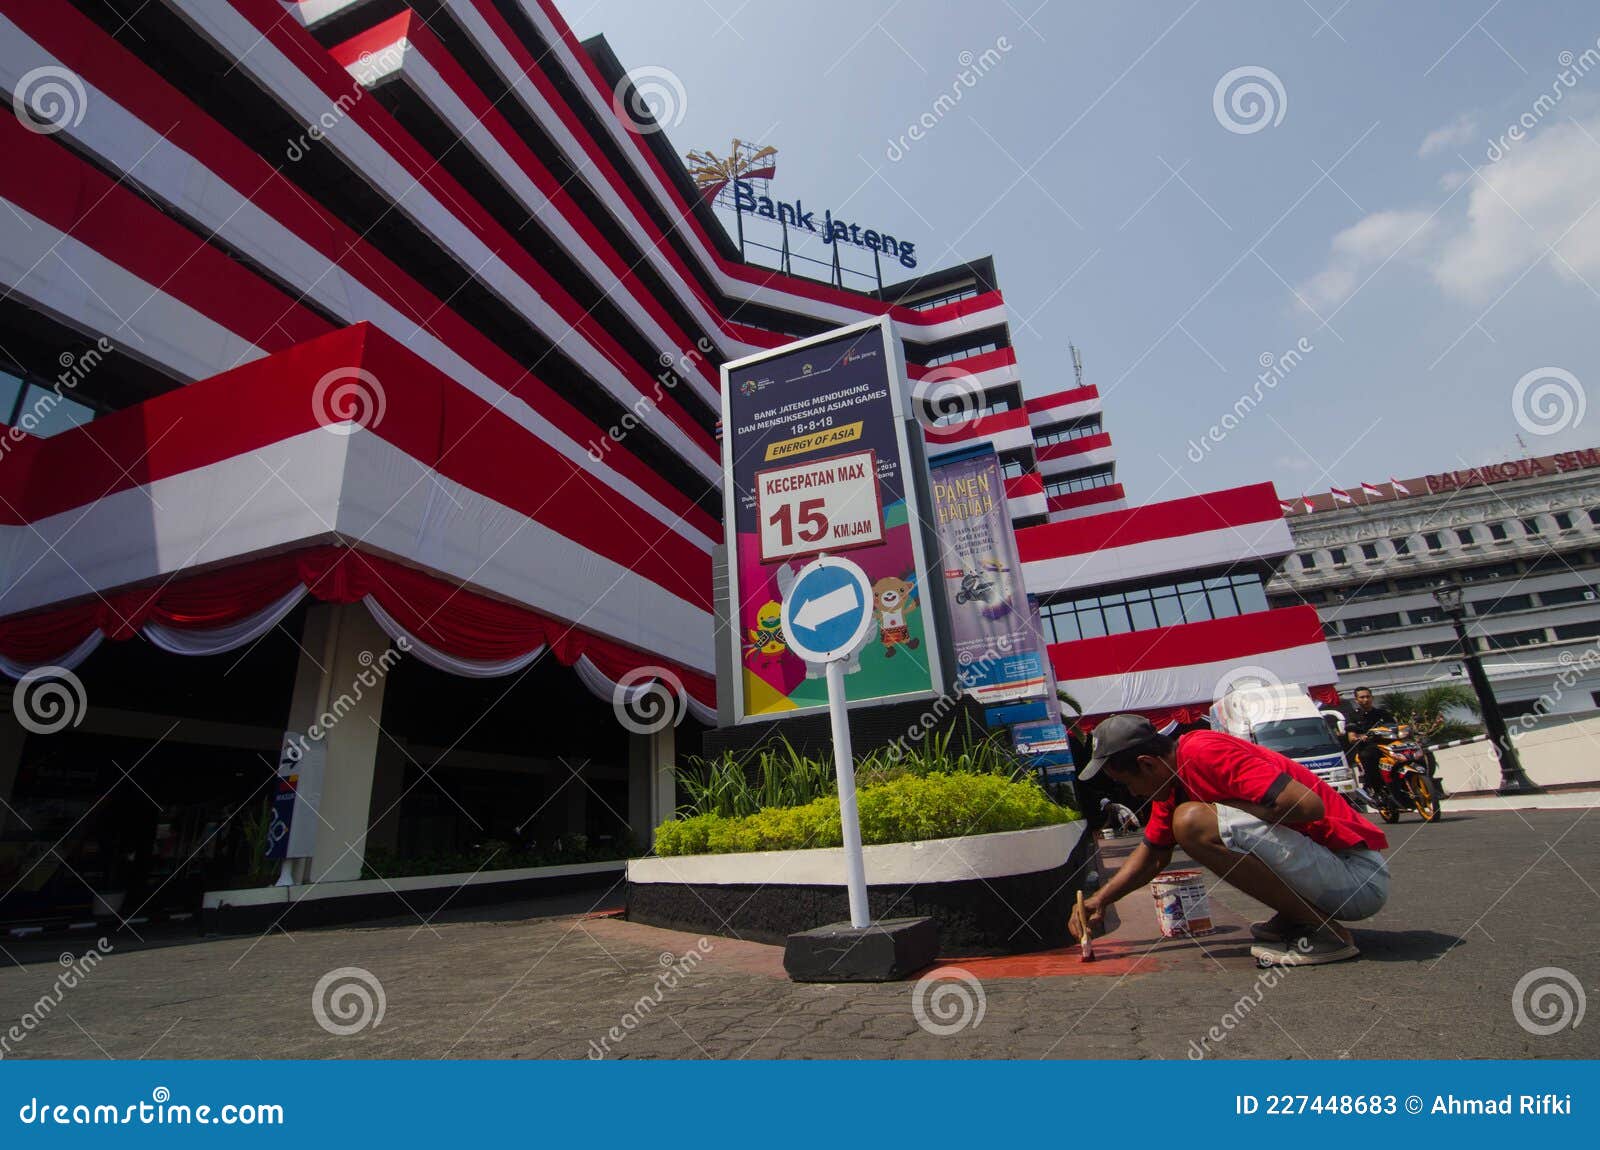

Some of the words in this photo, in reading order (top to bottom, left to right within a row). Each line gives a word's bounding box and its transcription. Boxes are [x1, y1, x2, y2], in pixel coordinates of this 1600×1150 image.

[734, 178, 816, 233] Bank
[823, 209, 917, 268] Jateng
[738, 423, 755, 435] DAN
[757, 406, 826, 430] MENSUKSESKAN
[827, 398, 853, 411] ASIAN
[855, 389, 887, 404] GAMES
[754, 409, 777, 421] BANK
[779, 399, 810, 415] JATENG
[812, 384, 869, 406] MENDUKUNG
[772, 439, 813, 456] ENERGY
[814, 435, 828, 445] OF
[829, 428, 855, 443] ASIA
[766, 470, 835, 495] KECEPATAN
[837, 463, 865, 480] MAX
[933, 472, 989, 504] PANEN
[769, 497, 829, 547] 15
[939, 494, 992, 525] HADIAH
[833, 520, 872, 538] KM/JAM
